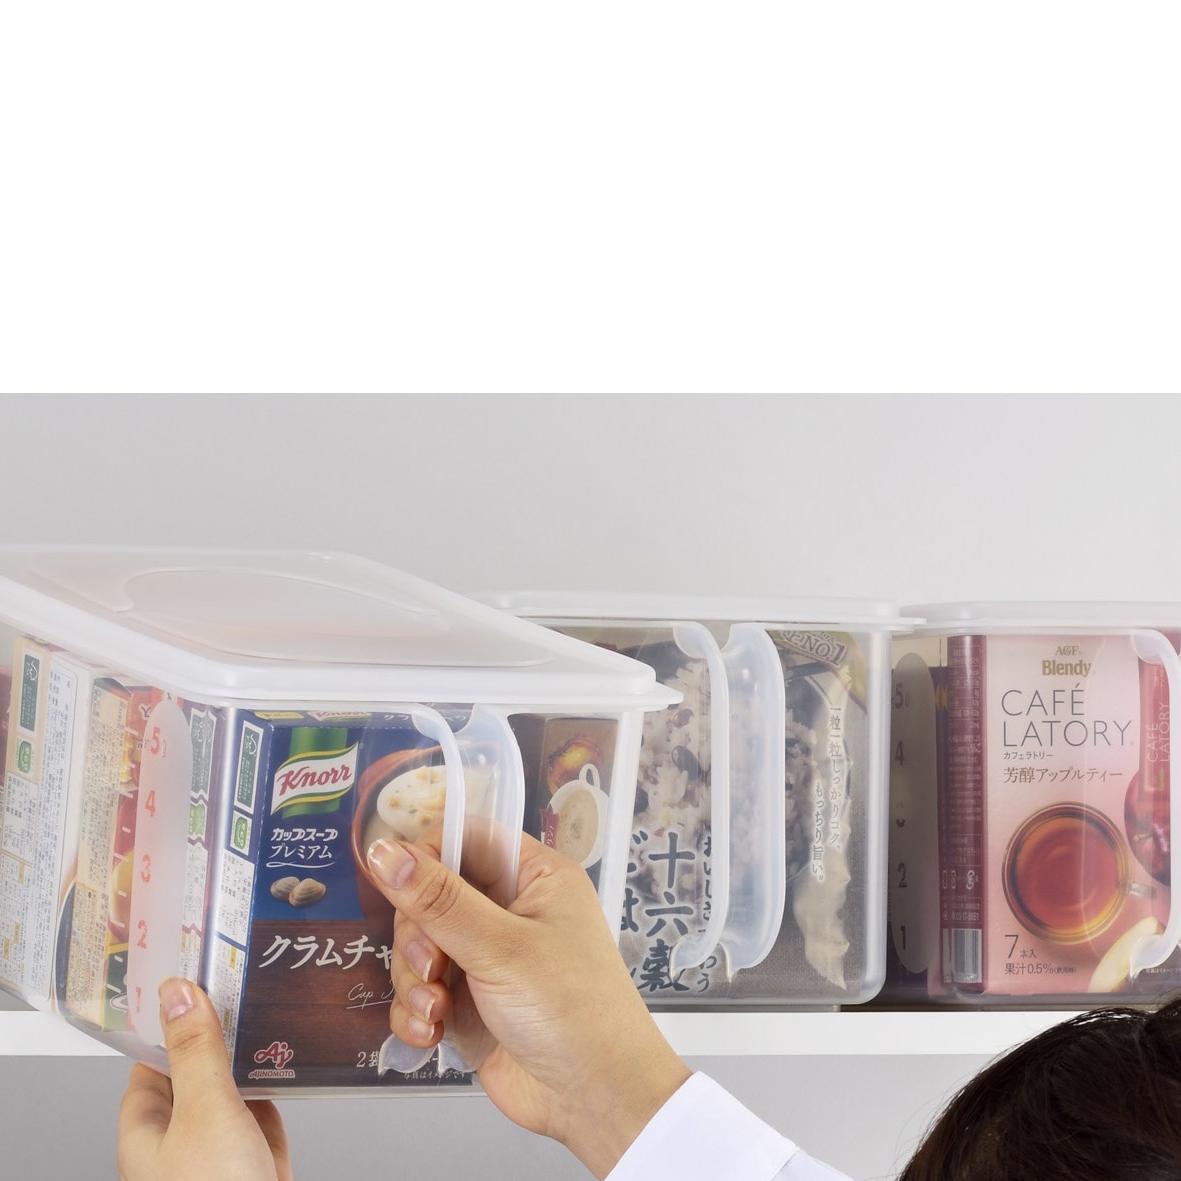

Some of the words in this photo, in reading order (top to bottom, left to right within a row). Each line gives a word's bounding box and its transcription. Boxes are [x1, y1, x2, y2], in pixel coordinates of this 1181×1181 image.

[1055, 645, 1079, 656] AGF
[1042, 660, 1092, 678] Blendy
[1001, 682, 1085, 717] CAFÉ
[1003, 719, 1132, 747] LATORY
[1003, 752, 1053, 760] カフェラトリー
[276, 764, 352, 796] Knorr
[1003, 766, 1123, 784] 芳醇アップルティー
[270, 828, 338, 841] カップスープ
[268, 843, 333, 860] プレミアム
